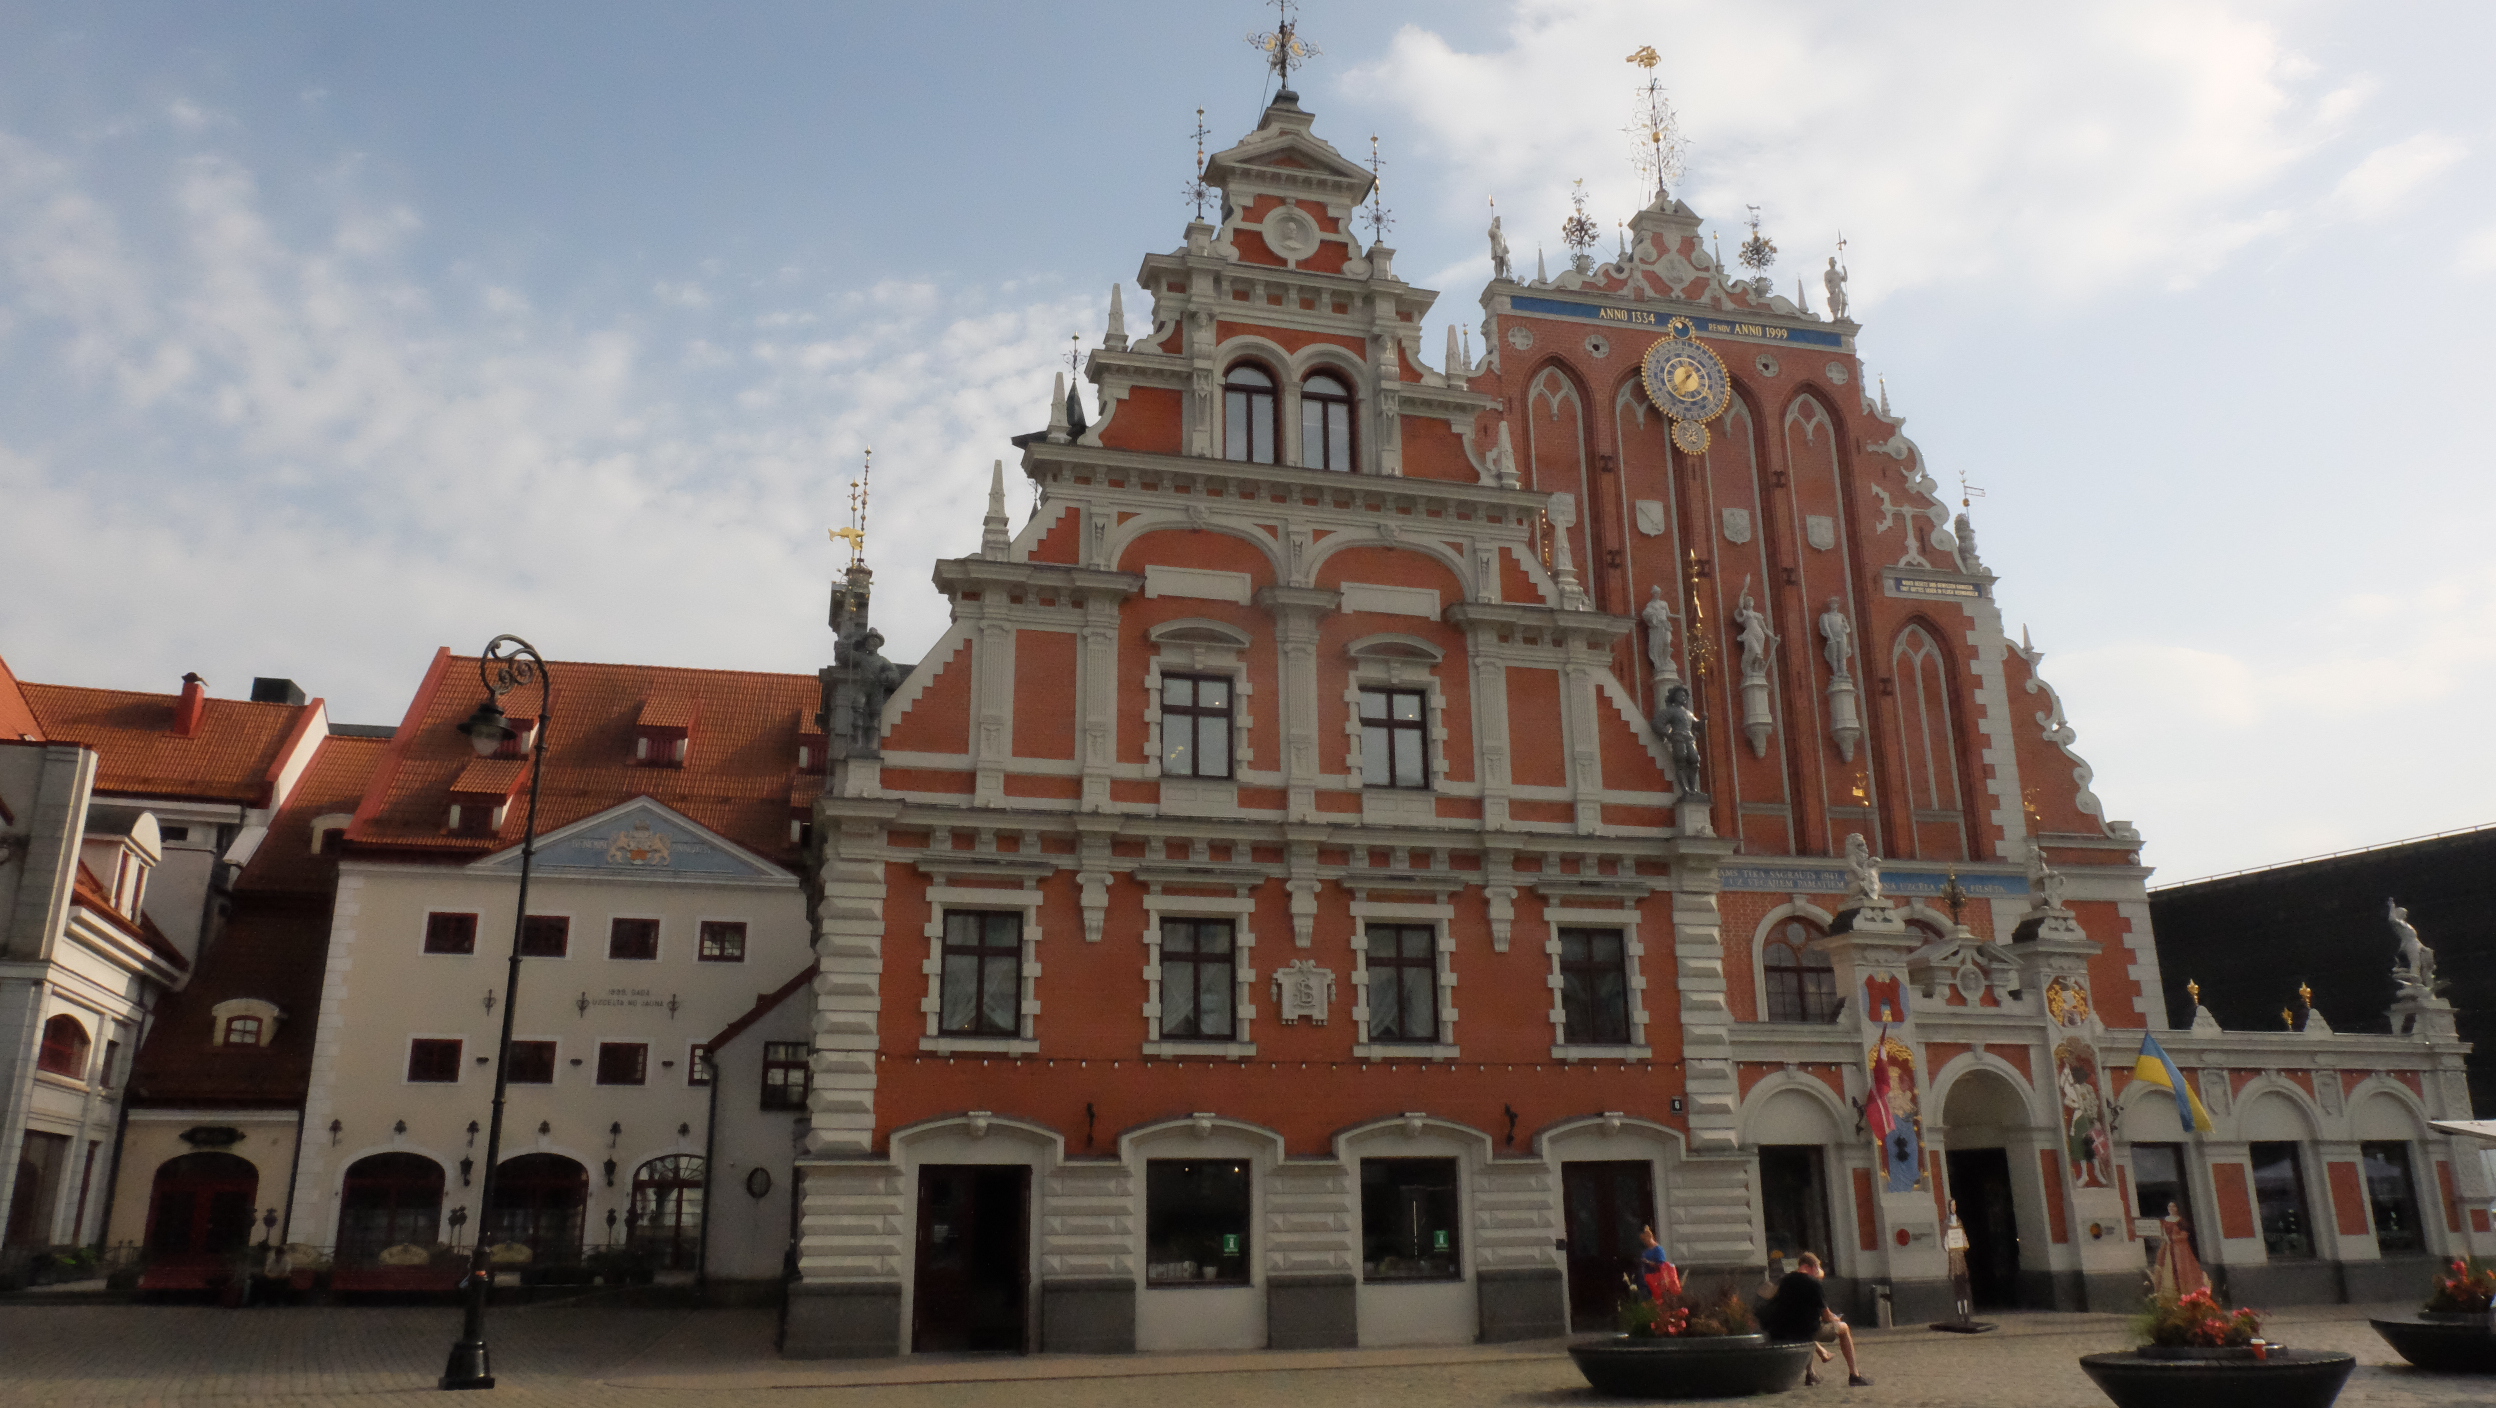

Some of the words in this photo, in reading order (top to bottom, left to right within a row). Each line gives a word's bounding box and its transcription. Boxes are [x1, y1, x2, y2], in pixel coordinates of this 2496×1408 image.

[1599, 307, 1628, 321] ANNO
[1631, 311, 1656, 325] 1334
[1734, 323, 1763, 337] ANNO
[1766, 327, 1788, 339] 1999
